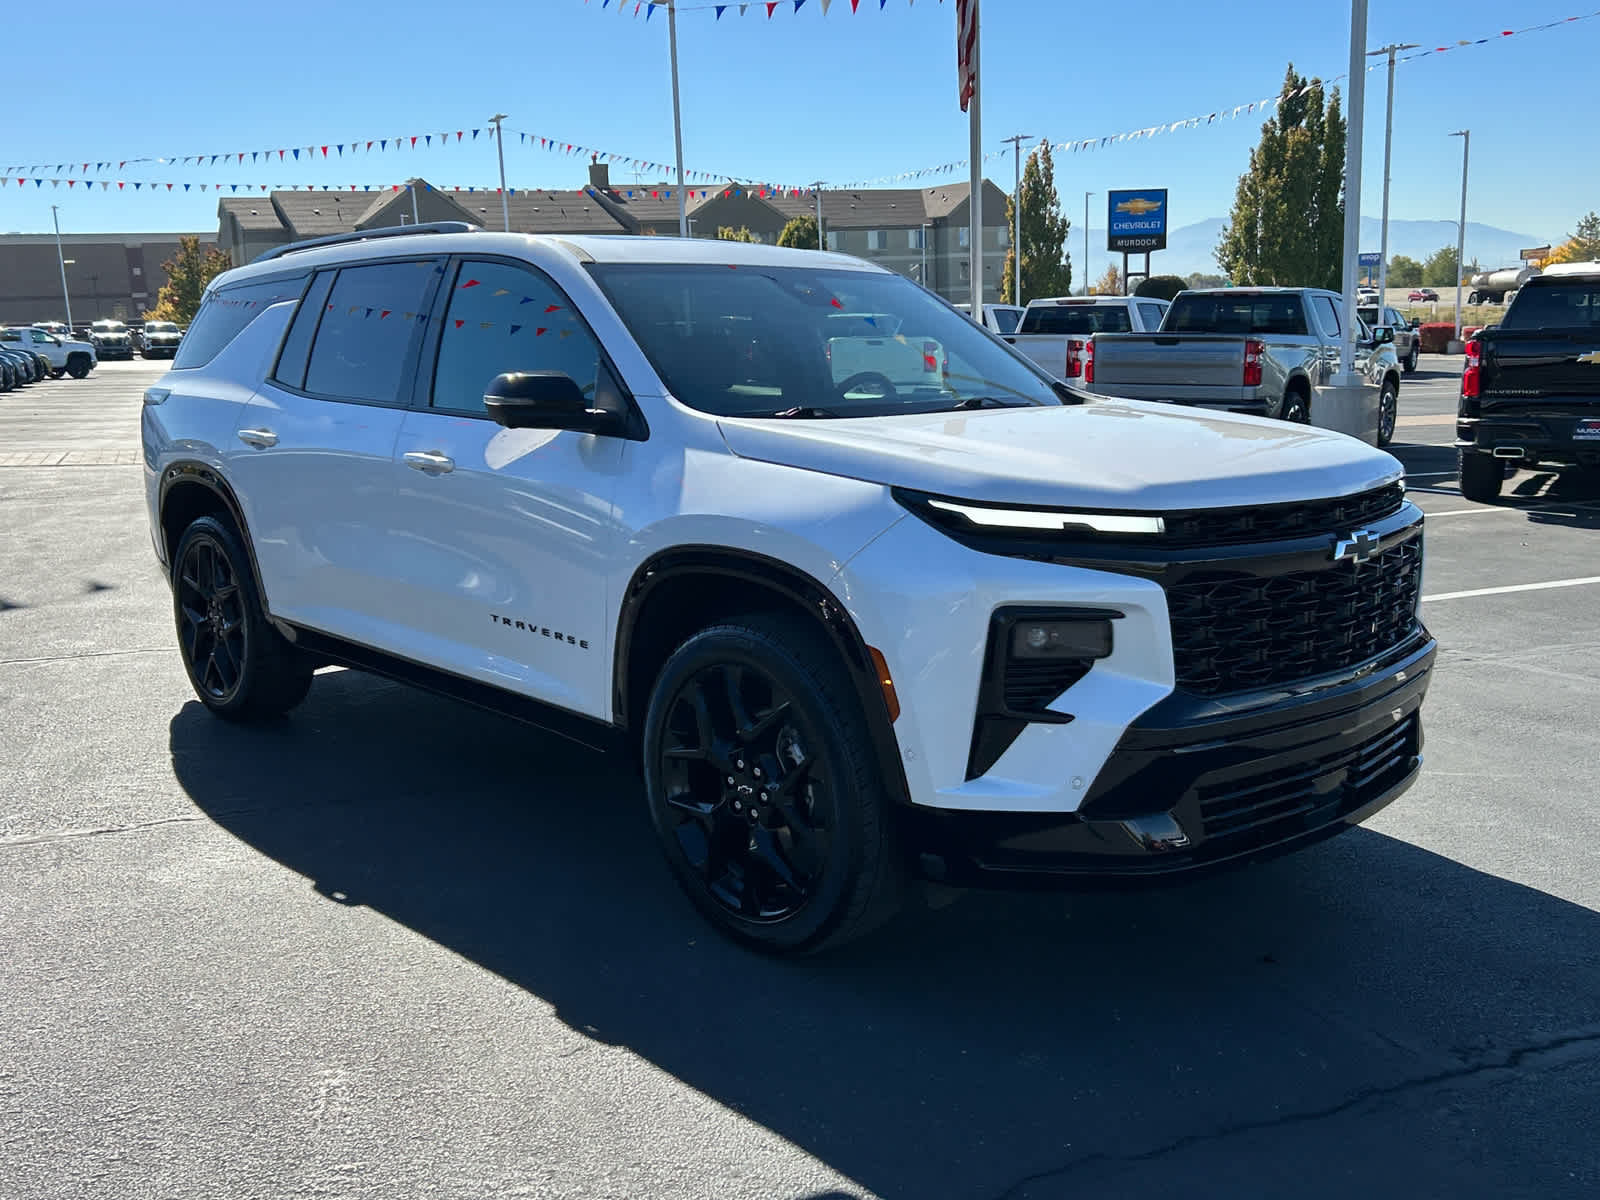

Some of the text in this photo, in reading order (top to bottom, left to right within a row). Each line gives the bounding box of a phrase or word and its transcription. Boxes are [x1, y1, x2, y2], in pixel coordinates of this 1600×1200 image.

[1113, 220, 1161, 231] CHEVROLET
[1116, 238, 1157, 248] MURDOCK
[489, 613, 589, 650] TRAVERSE
